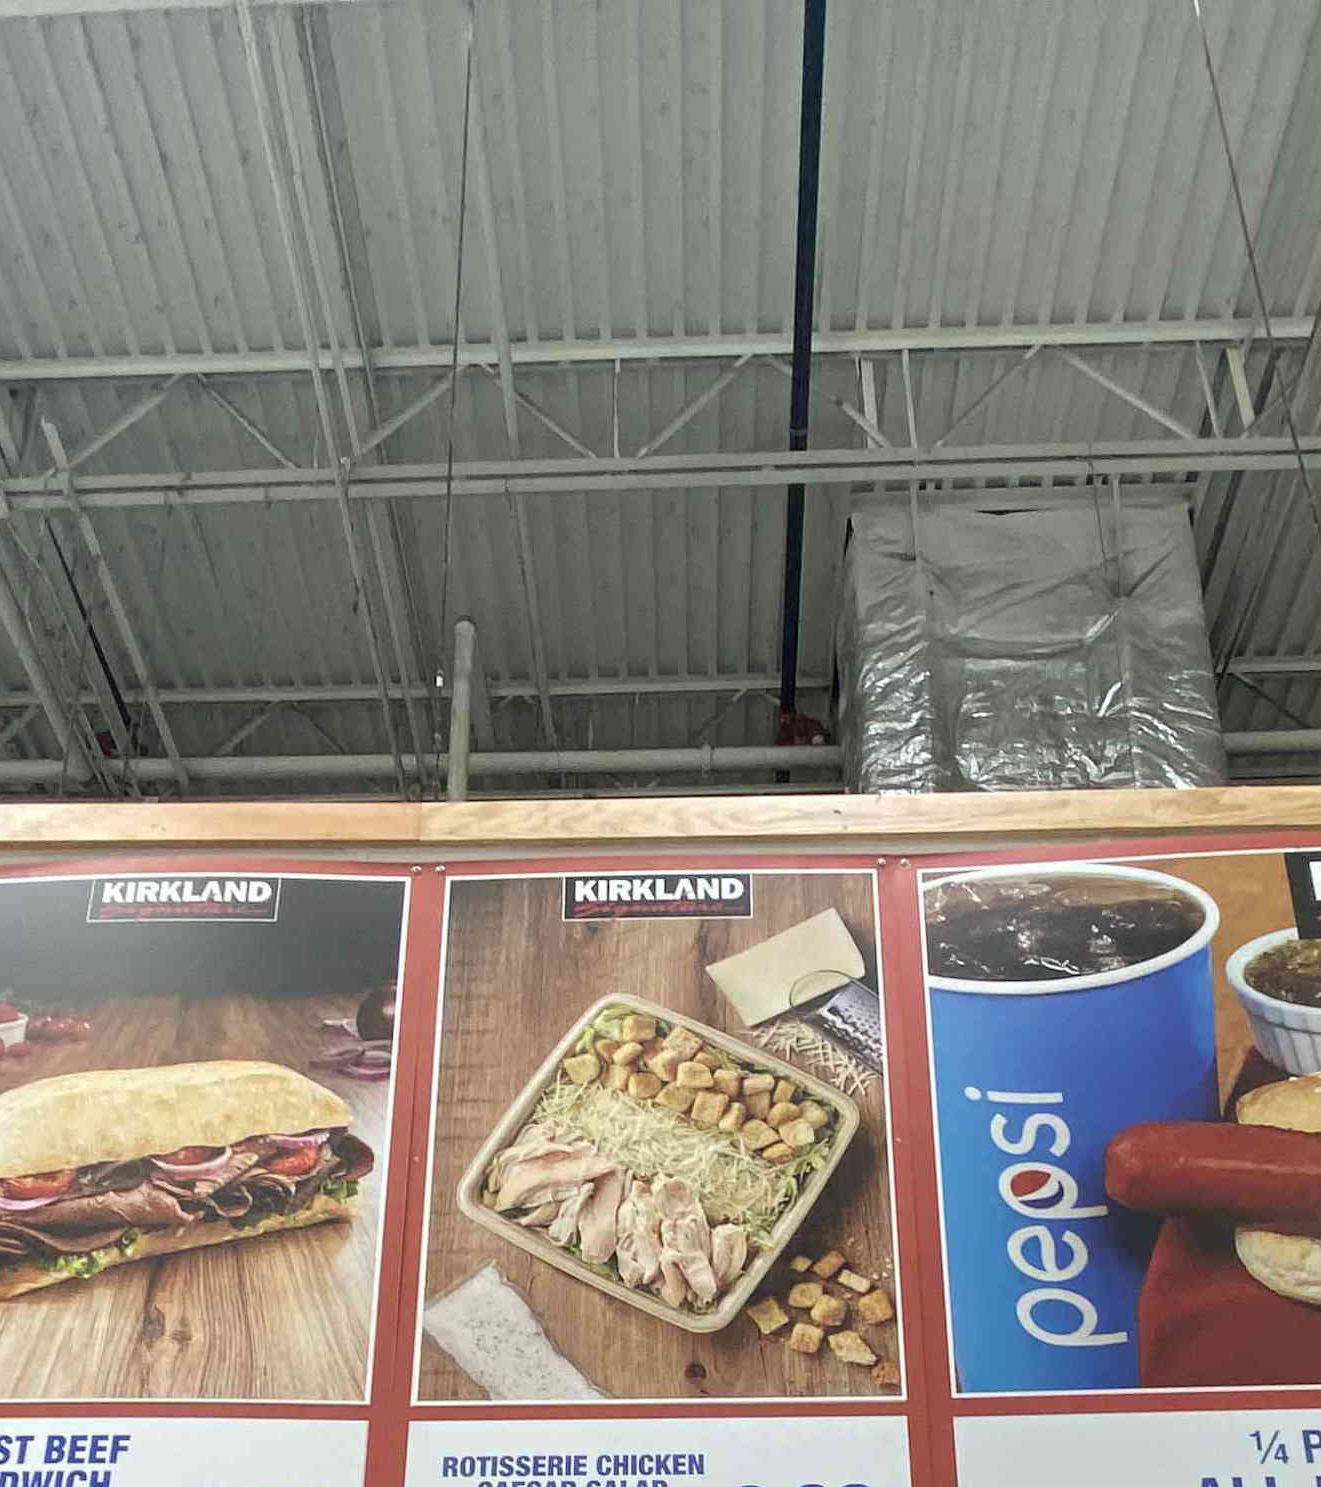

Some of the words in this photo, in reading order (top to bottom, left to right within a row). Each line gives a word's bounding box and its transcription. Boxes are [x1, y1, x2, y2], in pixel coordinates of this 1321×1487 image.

[102, 880, 272, 903] KIRKLAND
[574, 878, 745, 902] KIRKLAND
[964, 1086, 1128, 1346] pepsi
[43, 1434, 131, 1464] BEEF
[442, 1455, 588, 1478] ROTISSERIE
[596, 1453, 705, 1476] CHICKEN
